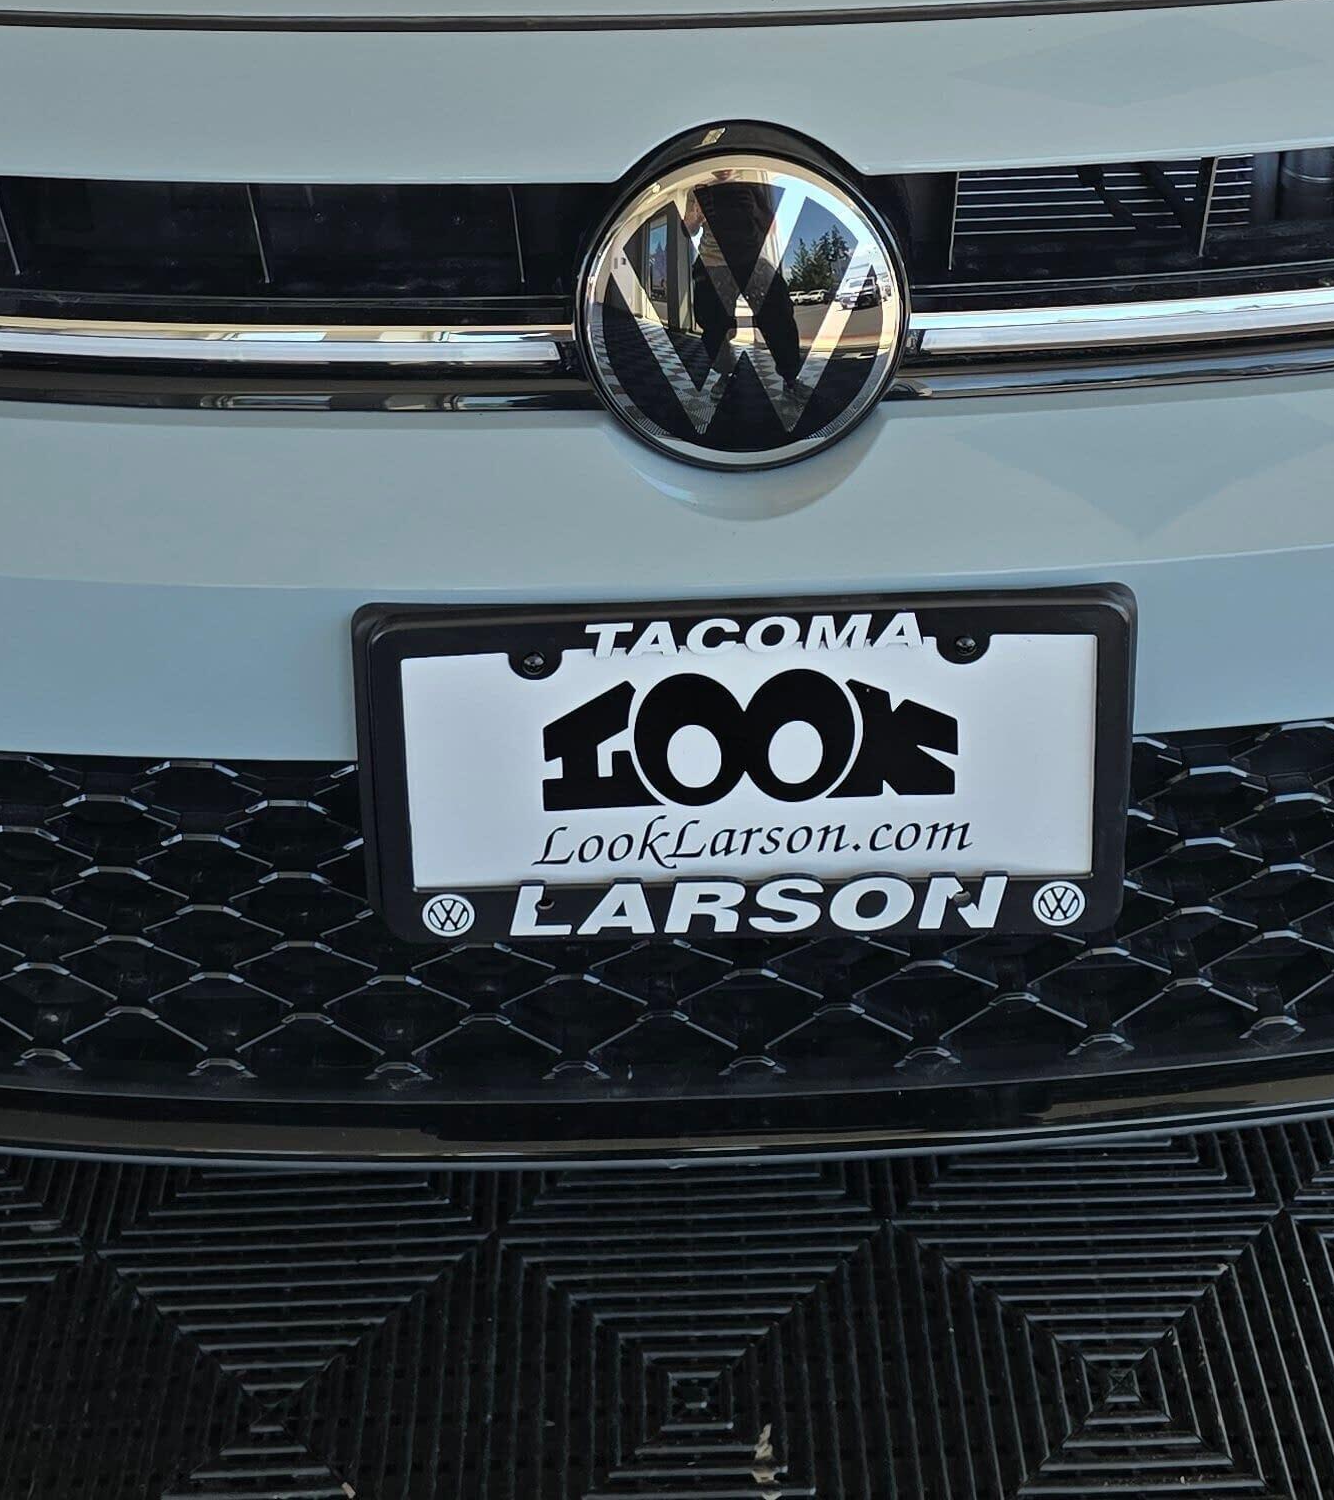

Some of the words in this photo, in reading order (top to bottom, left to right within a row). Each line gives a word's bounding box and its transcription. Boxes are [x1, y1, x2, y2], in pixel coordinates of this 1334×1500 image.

[584, 612, 925, 658] TACOMA
[542, 668, 959, 812] LOOK
[530, 814, 974, 869] LookLarson.com
[509, 873, 1011, 938] LARSON
